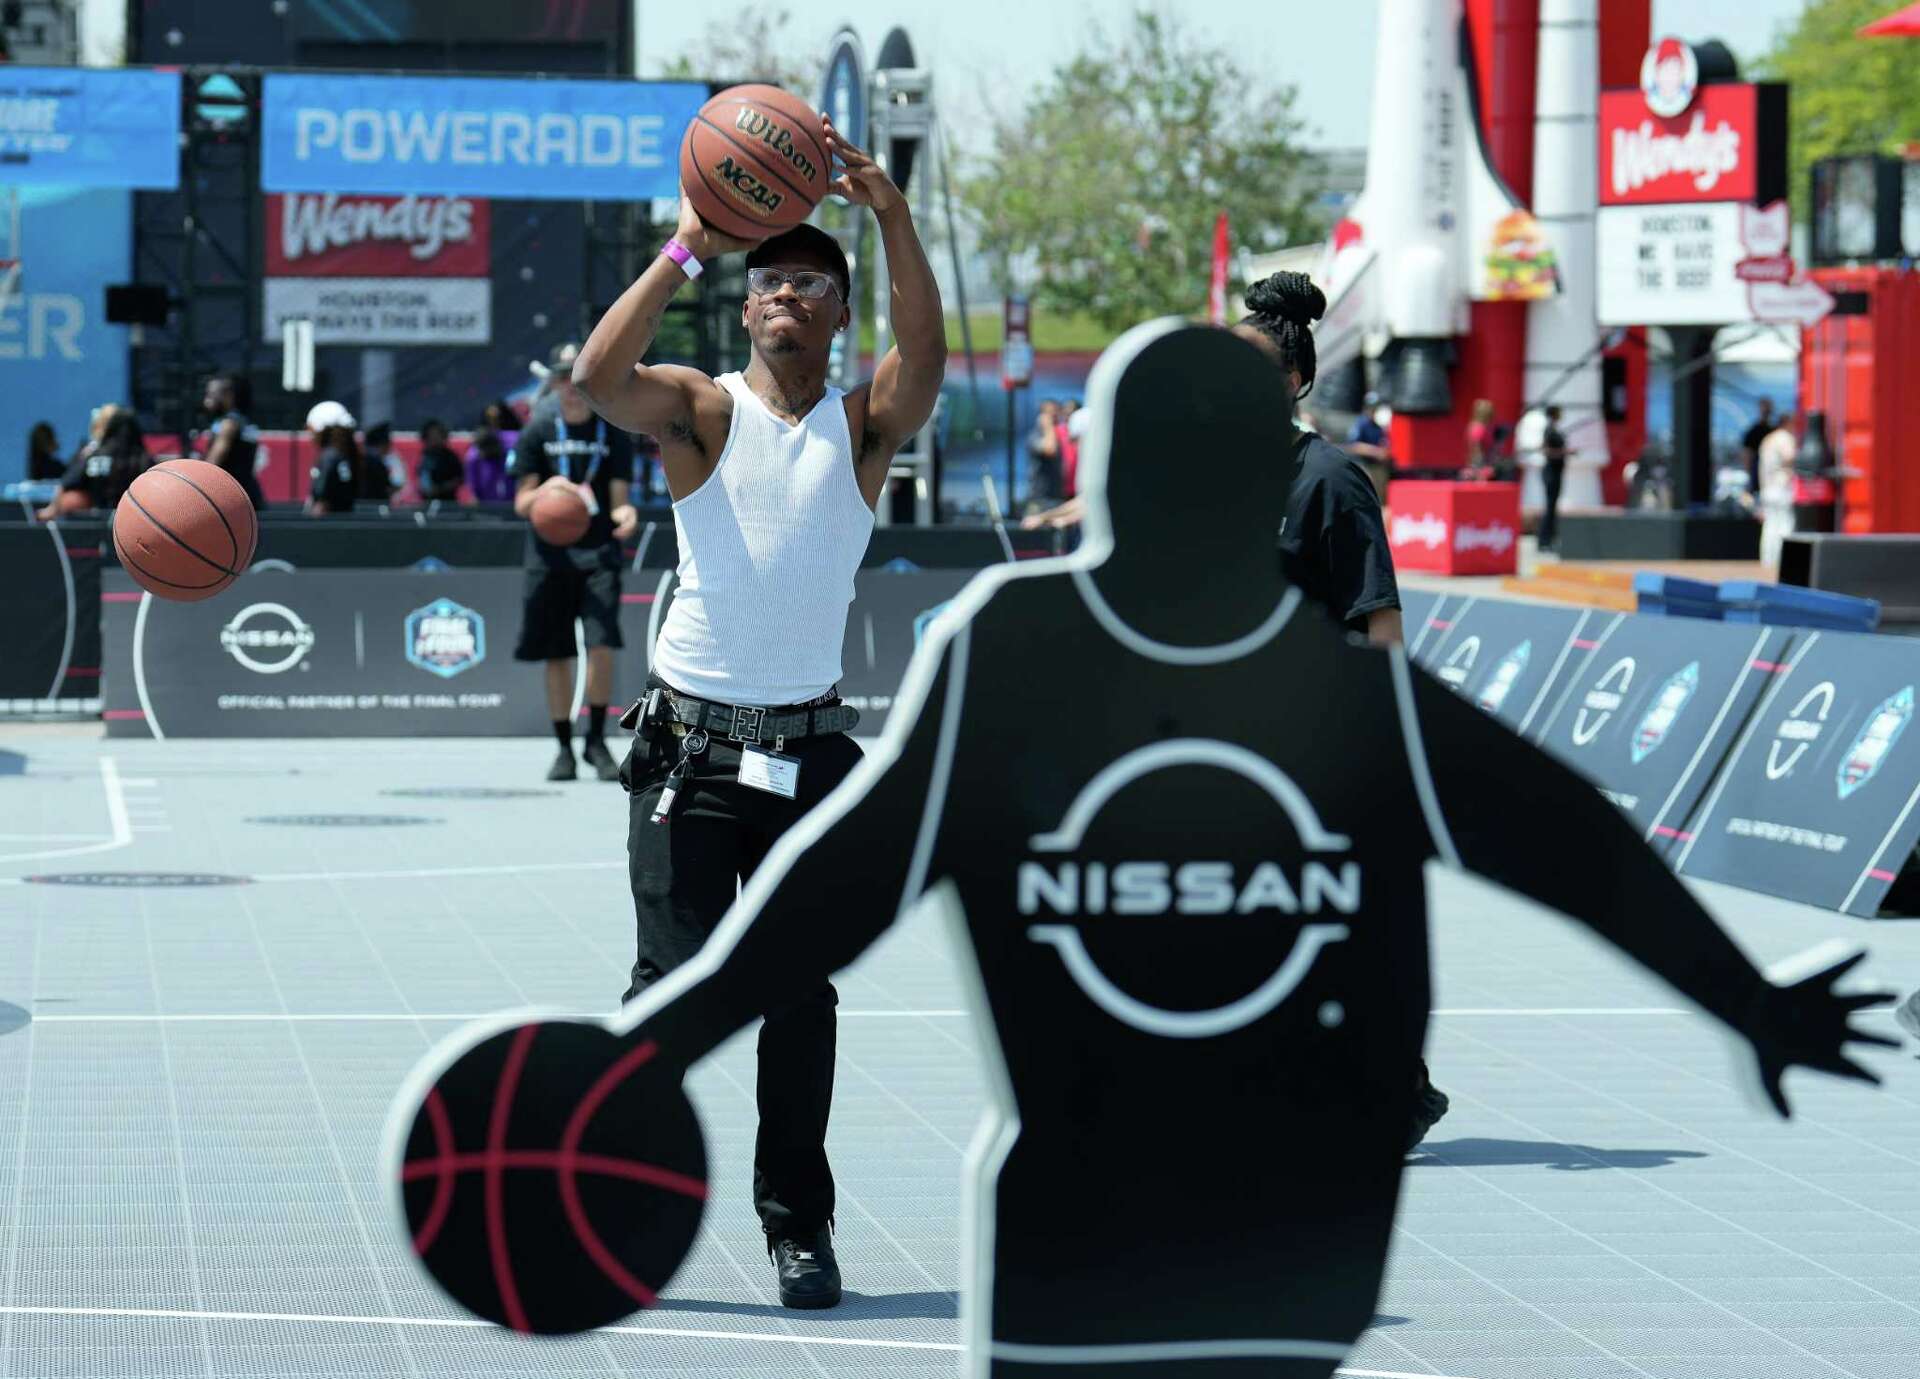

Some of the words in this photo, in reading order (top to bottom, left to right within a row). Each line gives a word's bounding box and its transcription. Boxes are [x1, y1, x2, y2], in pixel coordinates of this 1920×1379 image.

[294, 108, 664, 168] POWERADE
[736, 107, 817, 182] Wilson
[1612, 112, 1740, 196] Wendy's
[715, 157, 783, 211] NCAA
[282, 192, 474, 259] Wendy's
[220, 630, 315, 647] NISSAN
[218, 695, 285, 709] OFFICIAL
[287, 695, 355, 709] PARTNER
[357, 695, 379, 708] OF
[382, 695, 411, 708] THE
[413, 695, 457, 708] FINAL
[458, 693, 502, 708] FOUR
[1018, 861, 1361, 915] NISSAN
